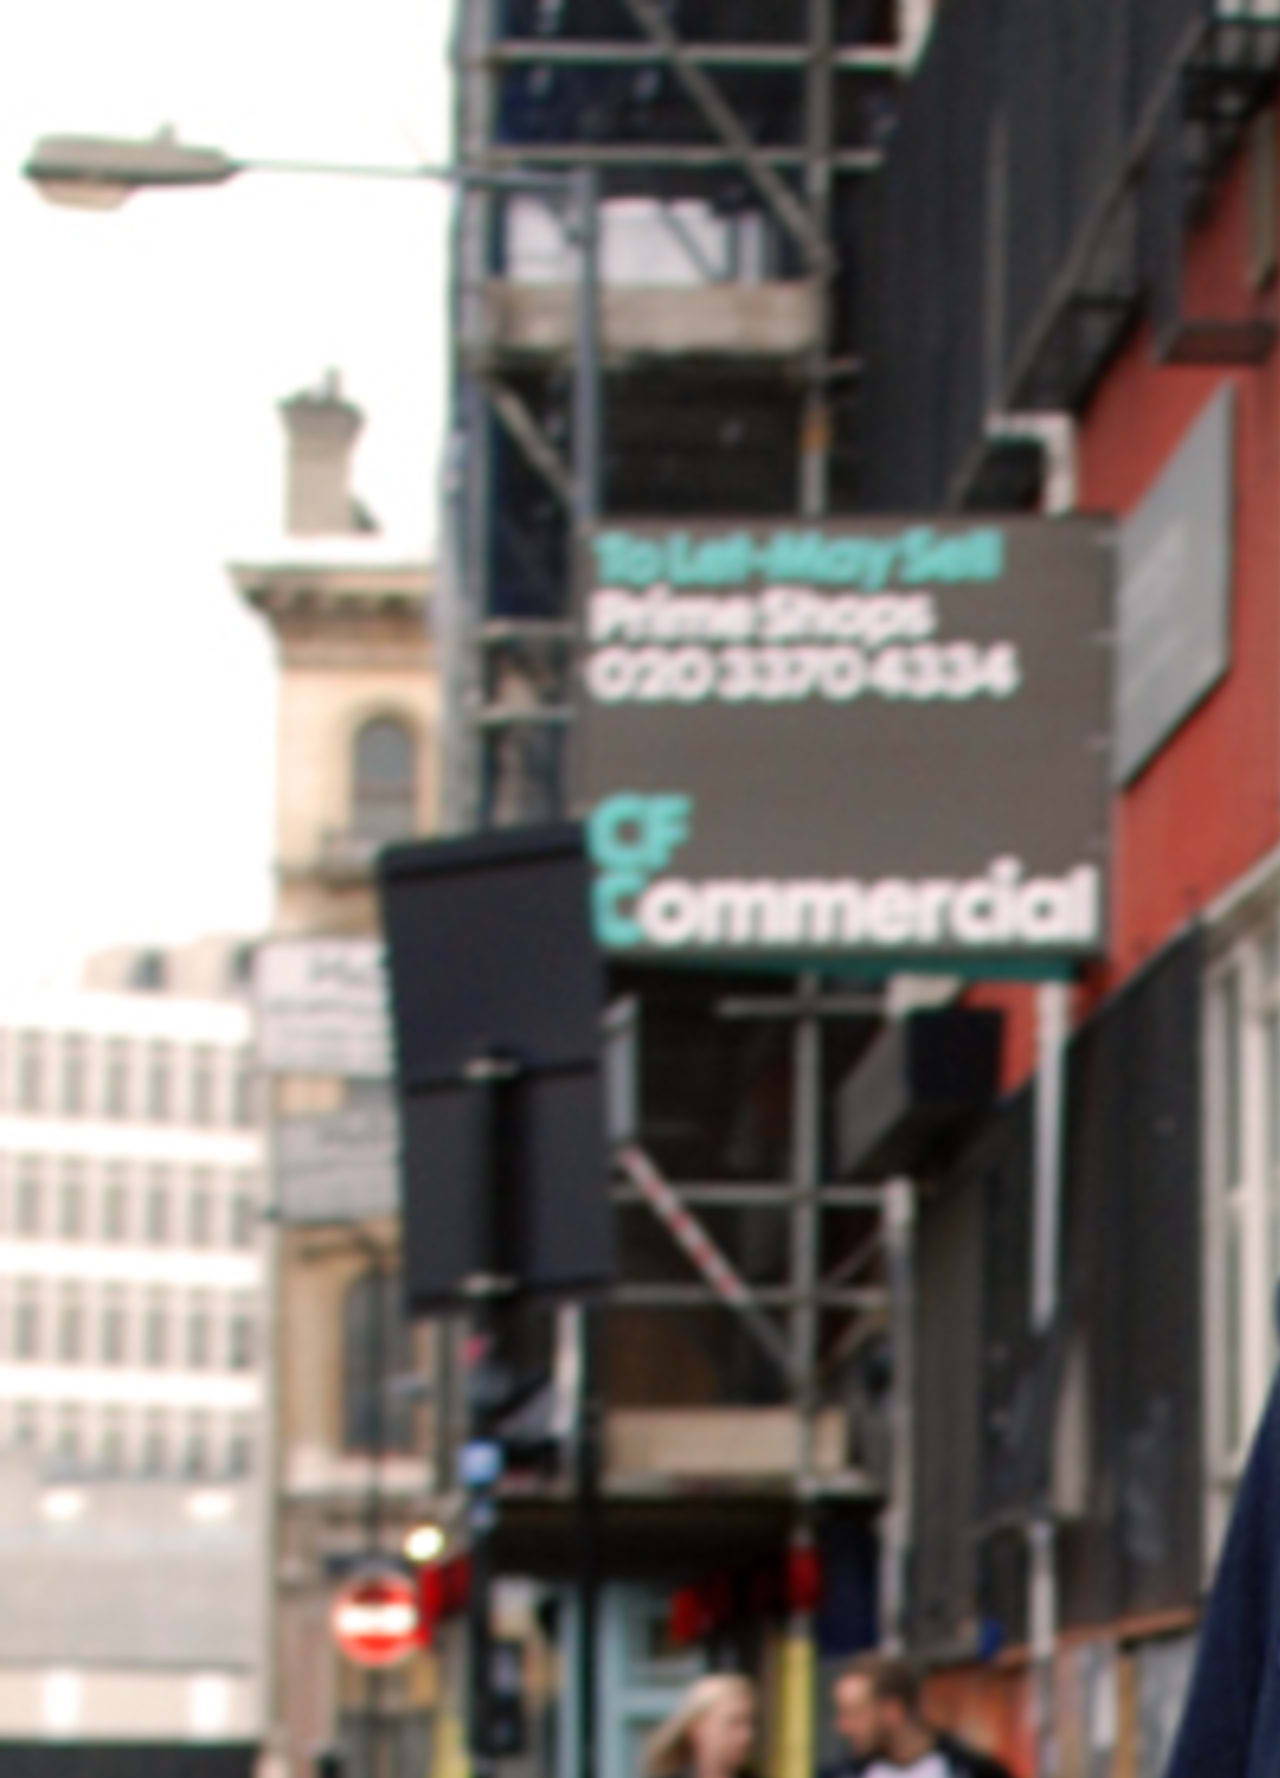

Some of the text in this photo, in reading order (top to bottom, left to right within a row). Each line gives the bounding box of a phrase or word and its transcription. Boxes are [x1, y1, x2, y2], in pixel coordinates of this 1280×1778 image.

[596, 534, 658, 582] To
[900, 526, 1004, 583] Sell
[590, 584, 936, 648] Prime Shops
[588, 645, 713, 702] 020
[718, 643, 867, 702] 3370
[596, 860, 1095, 944] Commercial
